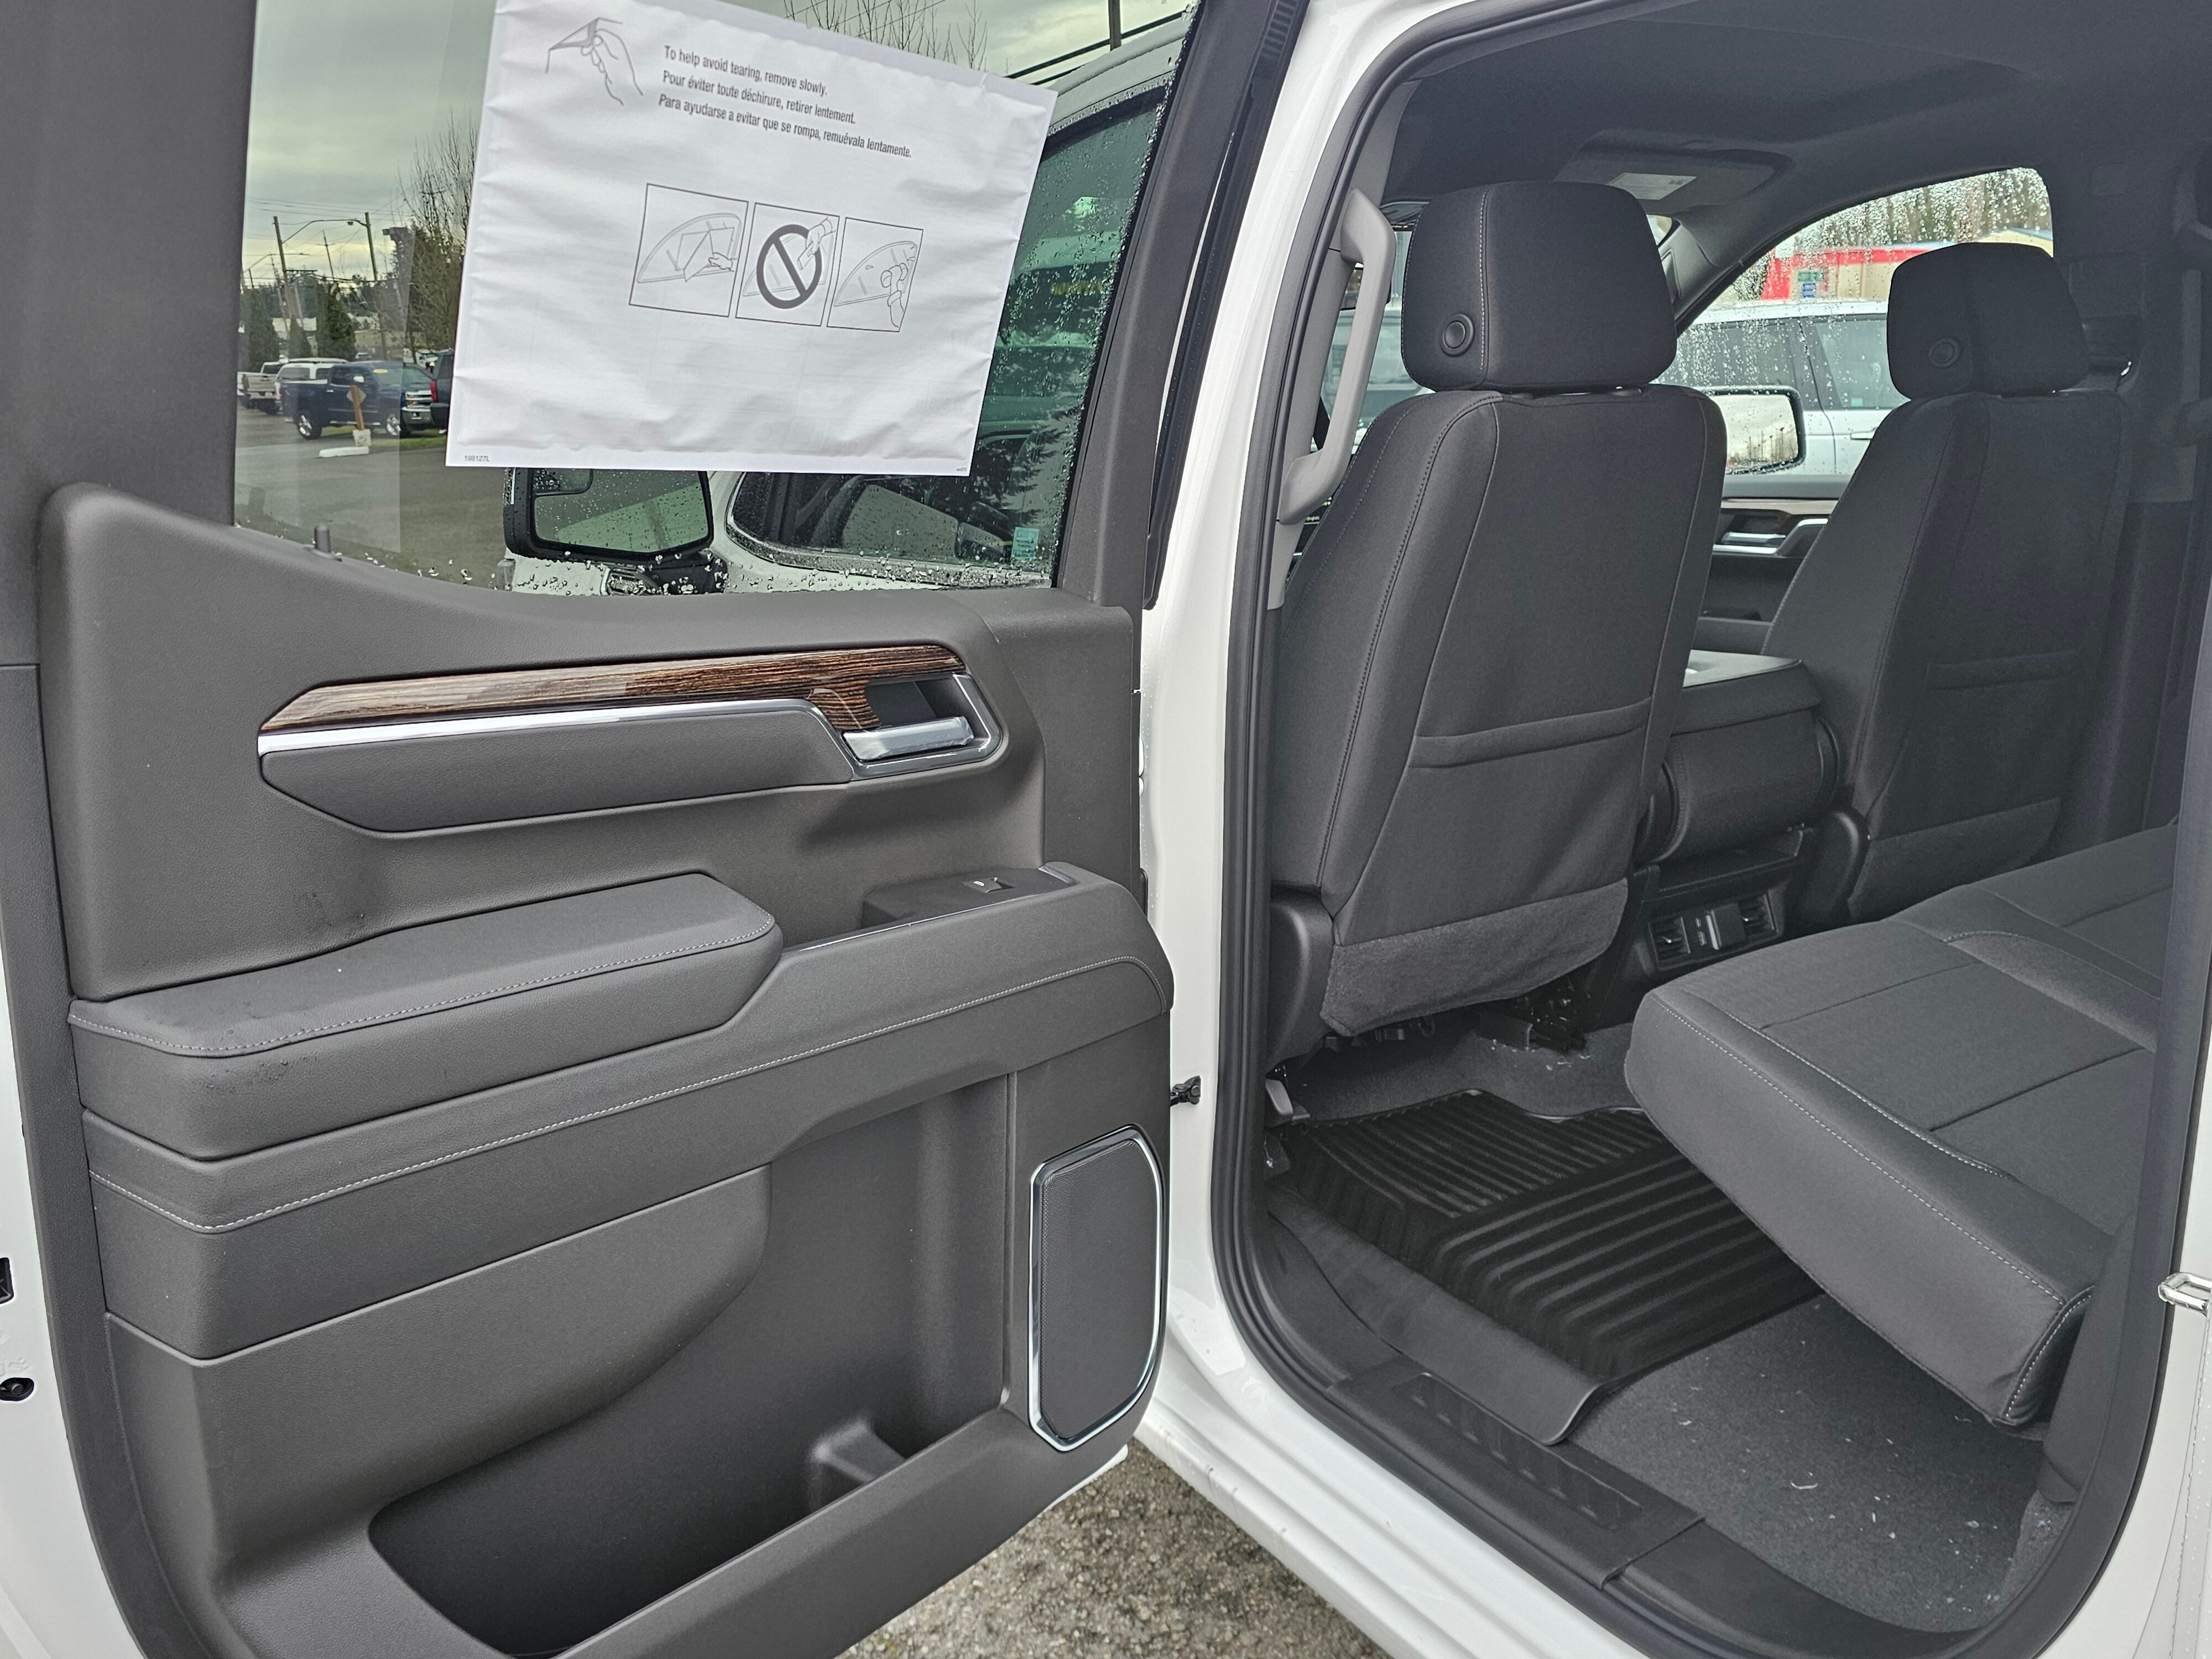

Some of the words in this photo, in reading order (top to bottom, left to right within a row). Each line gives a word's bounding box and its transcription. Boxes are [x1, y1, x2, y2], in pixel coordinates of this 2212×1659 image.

[662, 70, 685, 86] Pour
[688, 75, 714, 93] éviter
[717, 82, 739, 98] toute
[742, 88, 783, 110] déchirure,
[786, 100, 813, 114] retirer
[815, 104, 855, 124] lentement.
[664, 45, 676, 60] To
[679, 49, 700, 67] help
[703, 56, 728, 72] avoid
[731, 61, 762, 82] tearing,
[765, 71, 797, 88] remove
[799, 78, 827, 97] slowly.
[658, 93, 681, 109] Para
[684, 101, 727, 119] ayudarse
[728, 111, 734, 121] a
[736, 112, 760, 126] evitar
[763, 118, 779, 131] que
[781, 122, 791, 133] se
[794, 124, 821, 142] rompa,
[823, 130, 864, 148] remuévala
[867, 138, 911, 158] lentamente.
